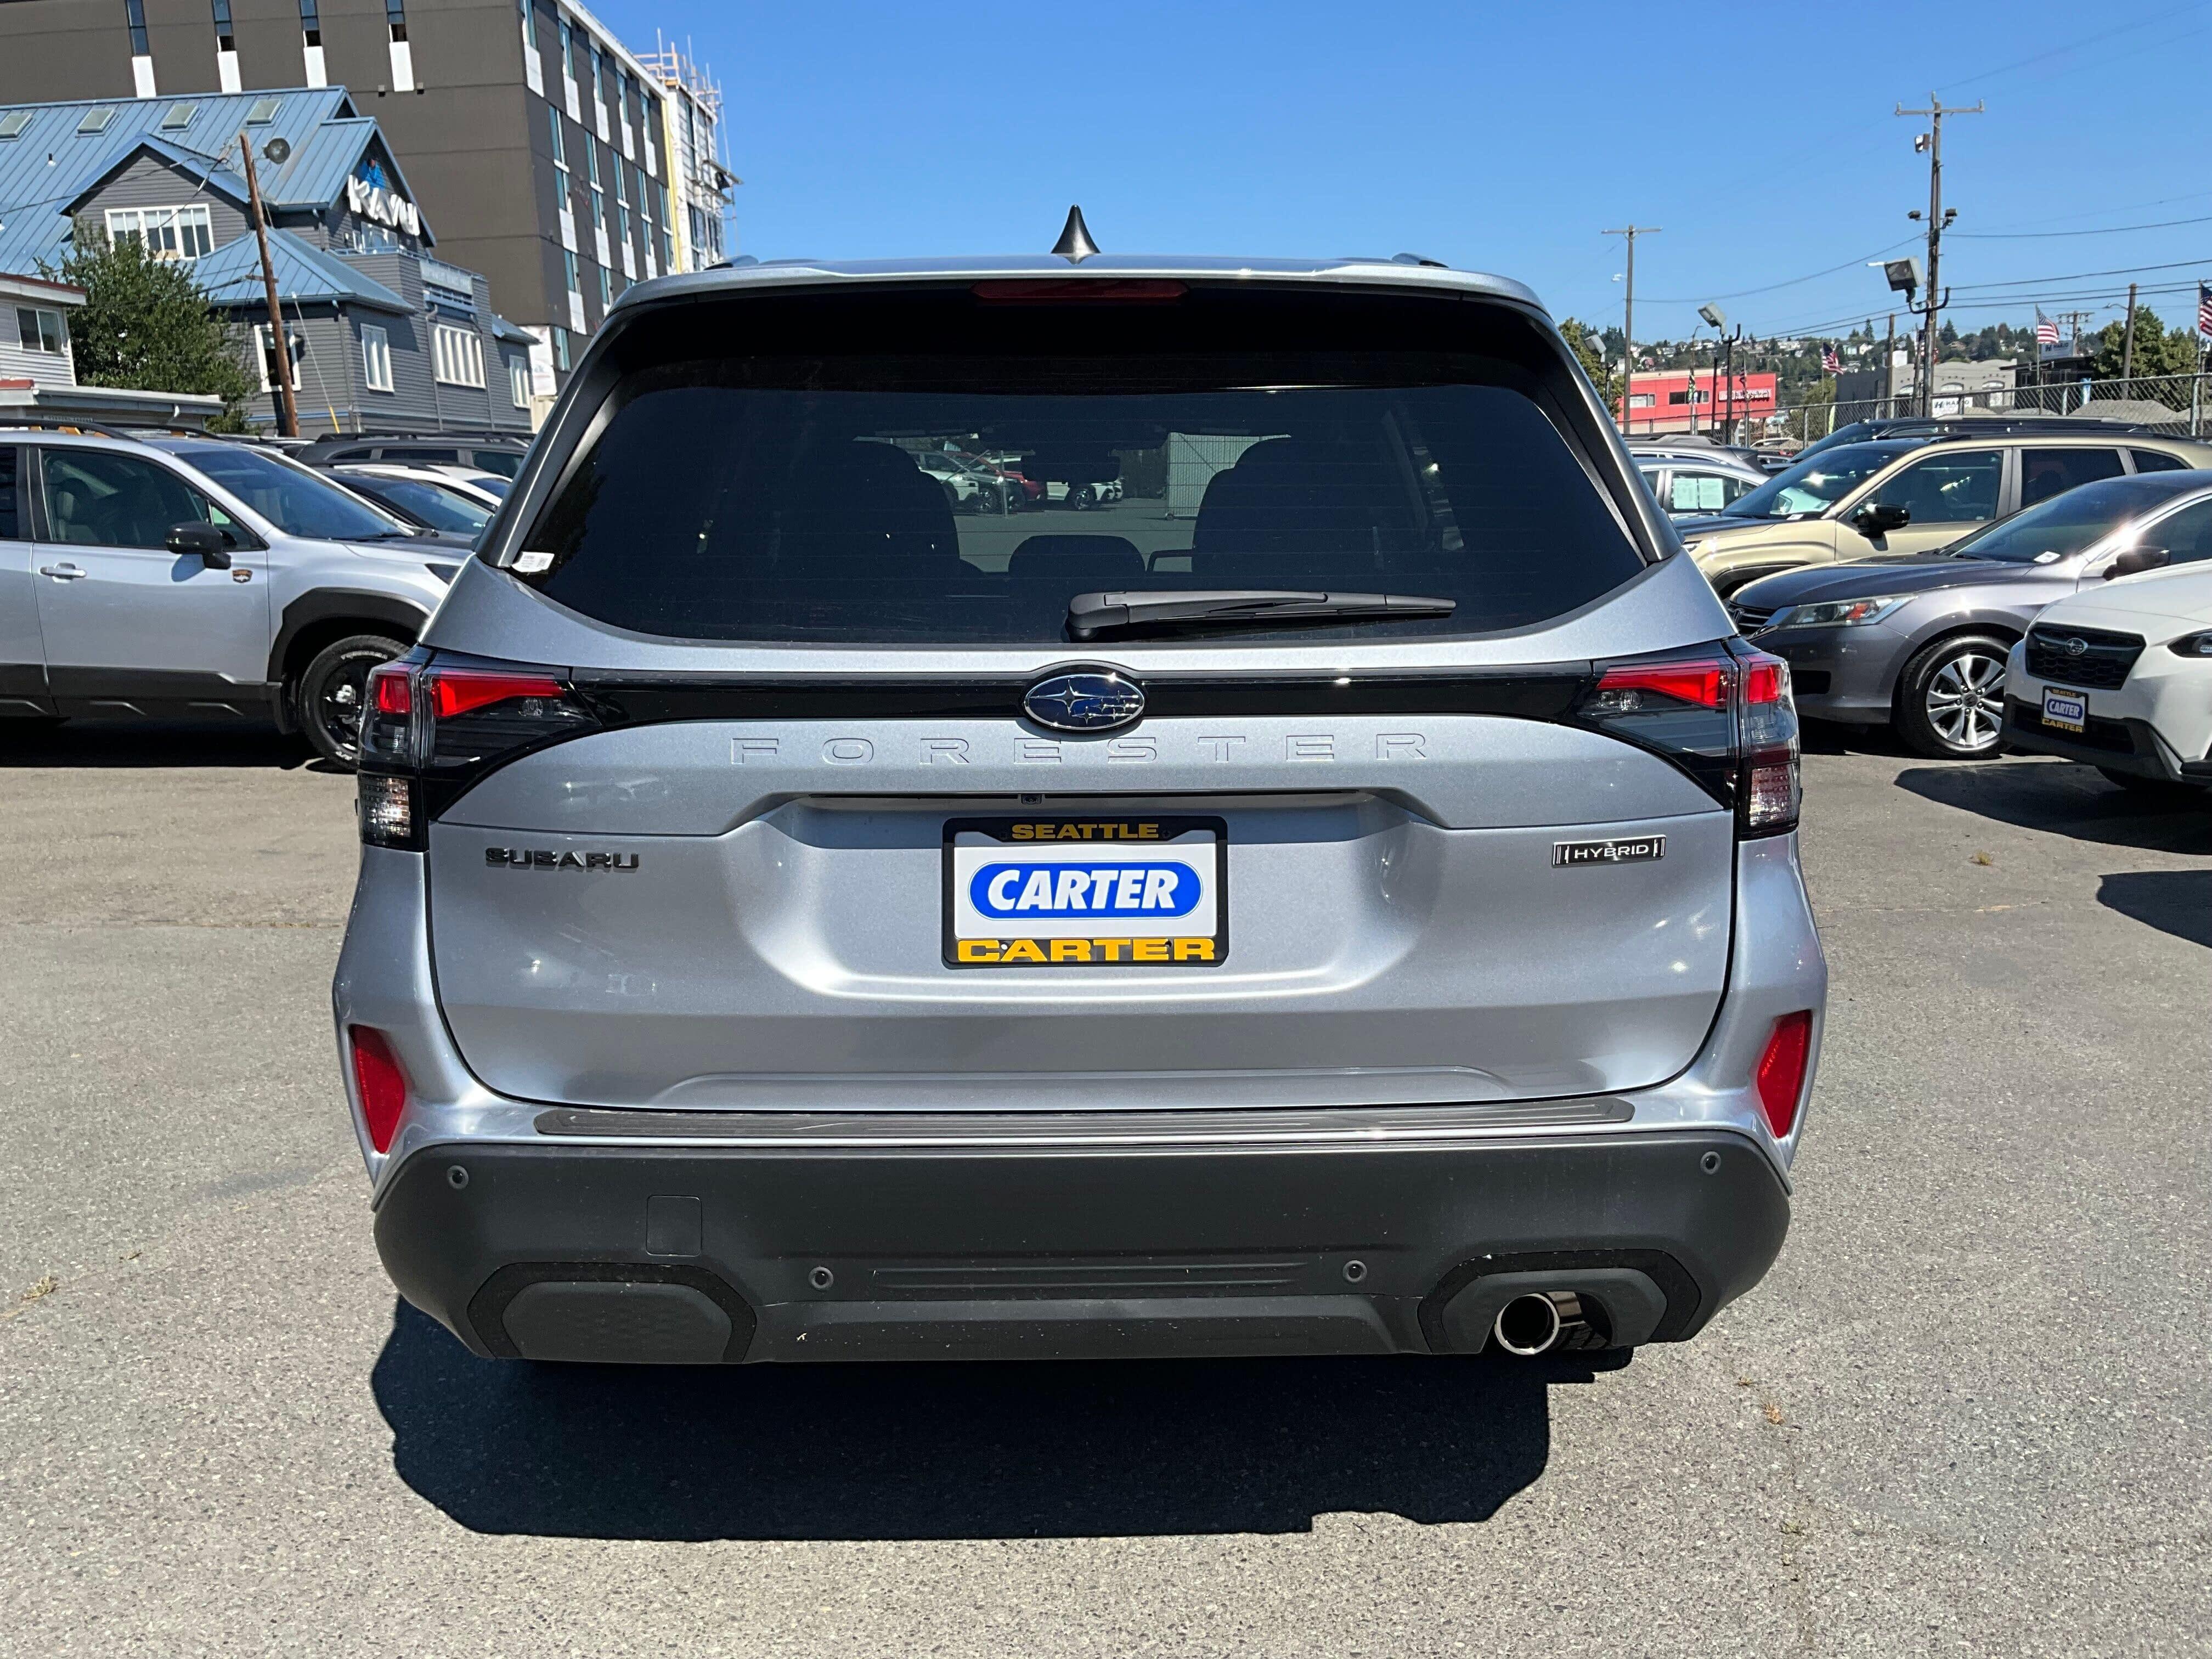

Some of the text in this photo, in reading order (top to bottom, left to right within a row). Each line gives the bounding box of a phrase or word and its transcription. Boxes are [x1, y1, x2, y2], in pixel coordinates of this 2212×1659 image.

[2049, 701, 2080, 717] CARTER
[2042, 718, 2083, 733] CARTER
[731, 732, 1427, 765] FORESTER
[1012, 823, 1159, 839] SEATTLE
[485, 847, 639, 869] SUBARU
[1574, 844, 1649, 859] HYBRID
[987, 869, 1179, 911] CARTER
[957, 938, 1216, 962] CARTER
